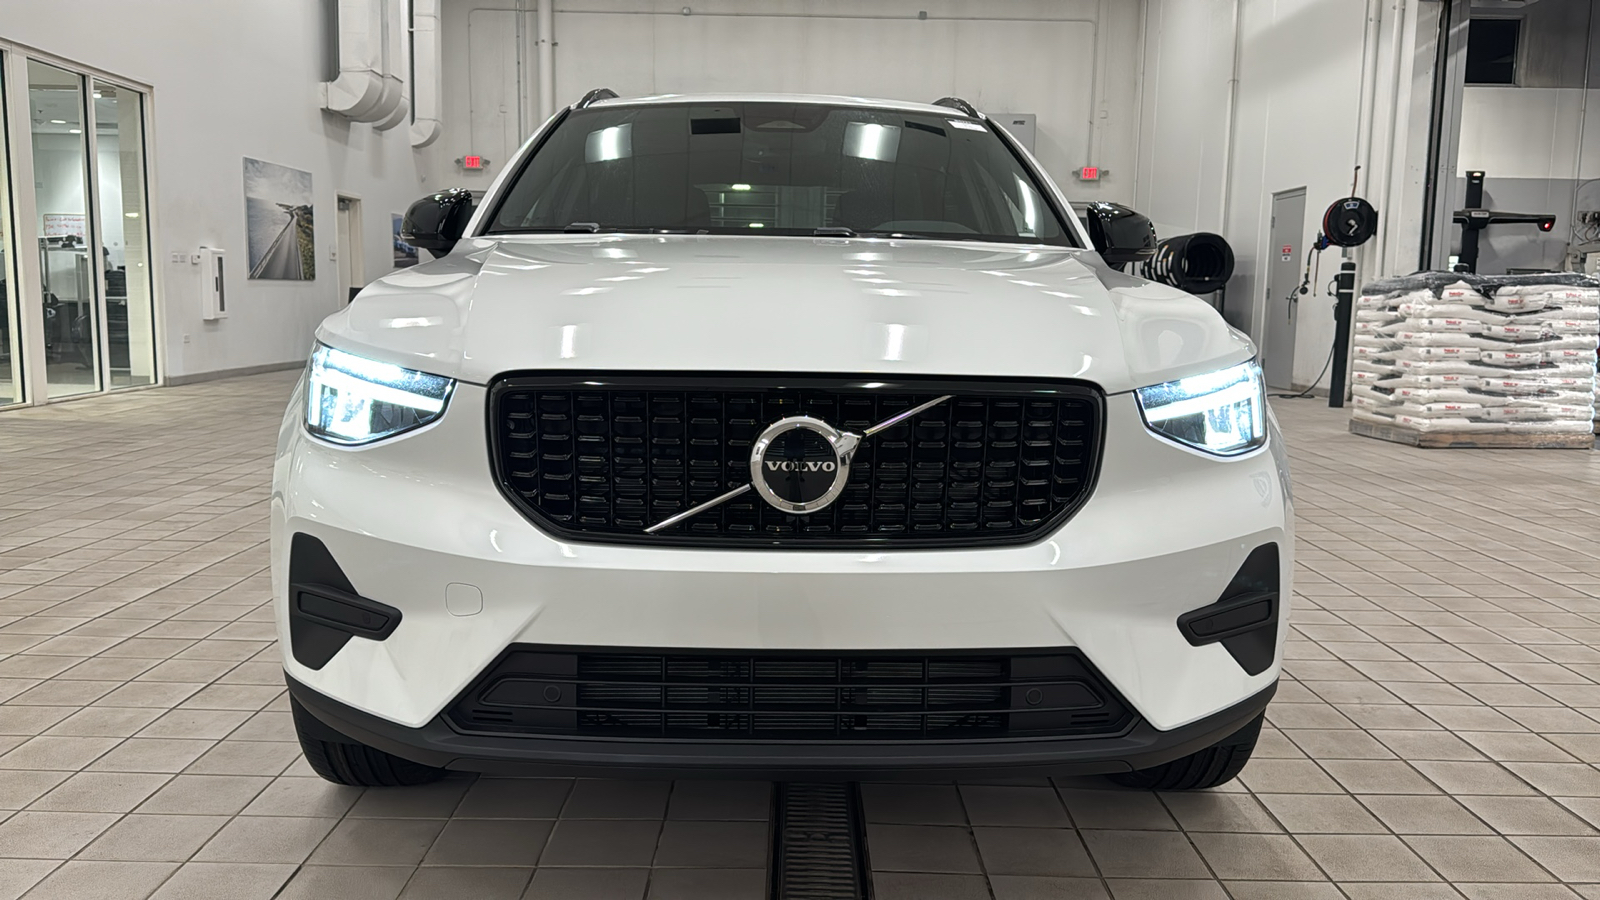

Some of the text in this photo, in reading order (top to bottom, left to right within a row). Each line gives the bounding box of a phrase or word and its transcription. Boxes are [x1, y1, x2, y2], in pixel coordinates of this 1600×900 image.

[466, 156, 480, 168] EXIT
[1082, 167, 1097, 179] EXIT
[765, 460, 836, 472] VOLVO
